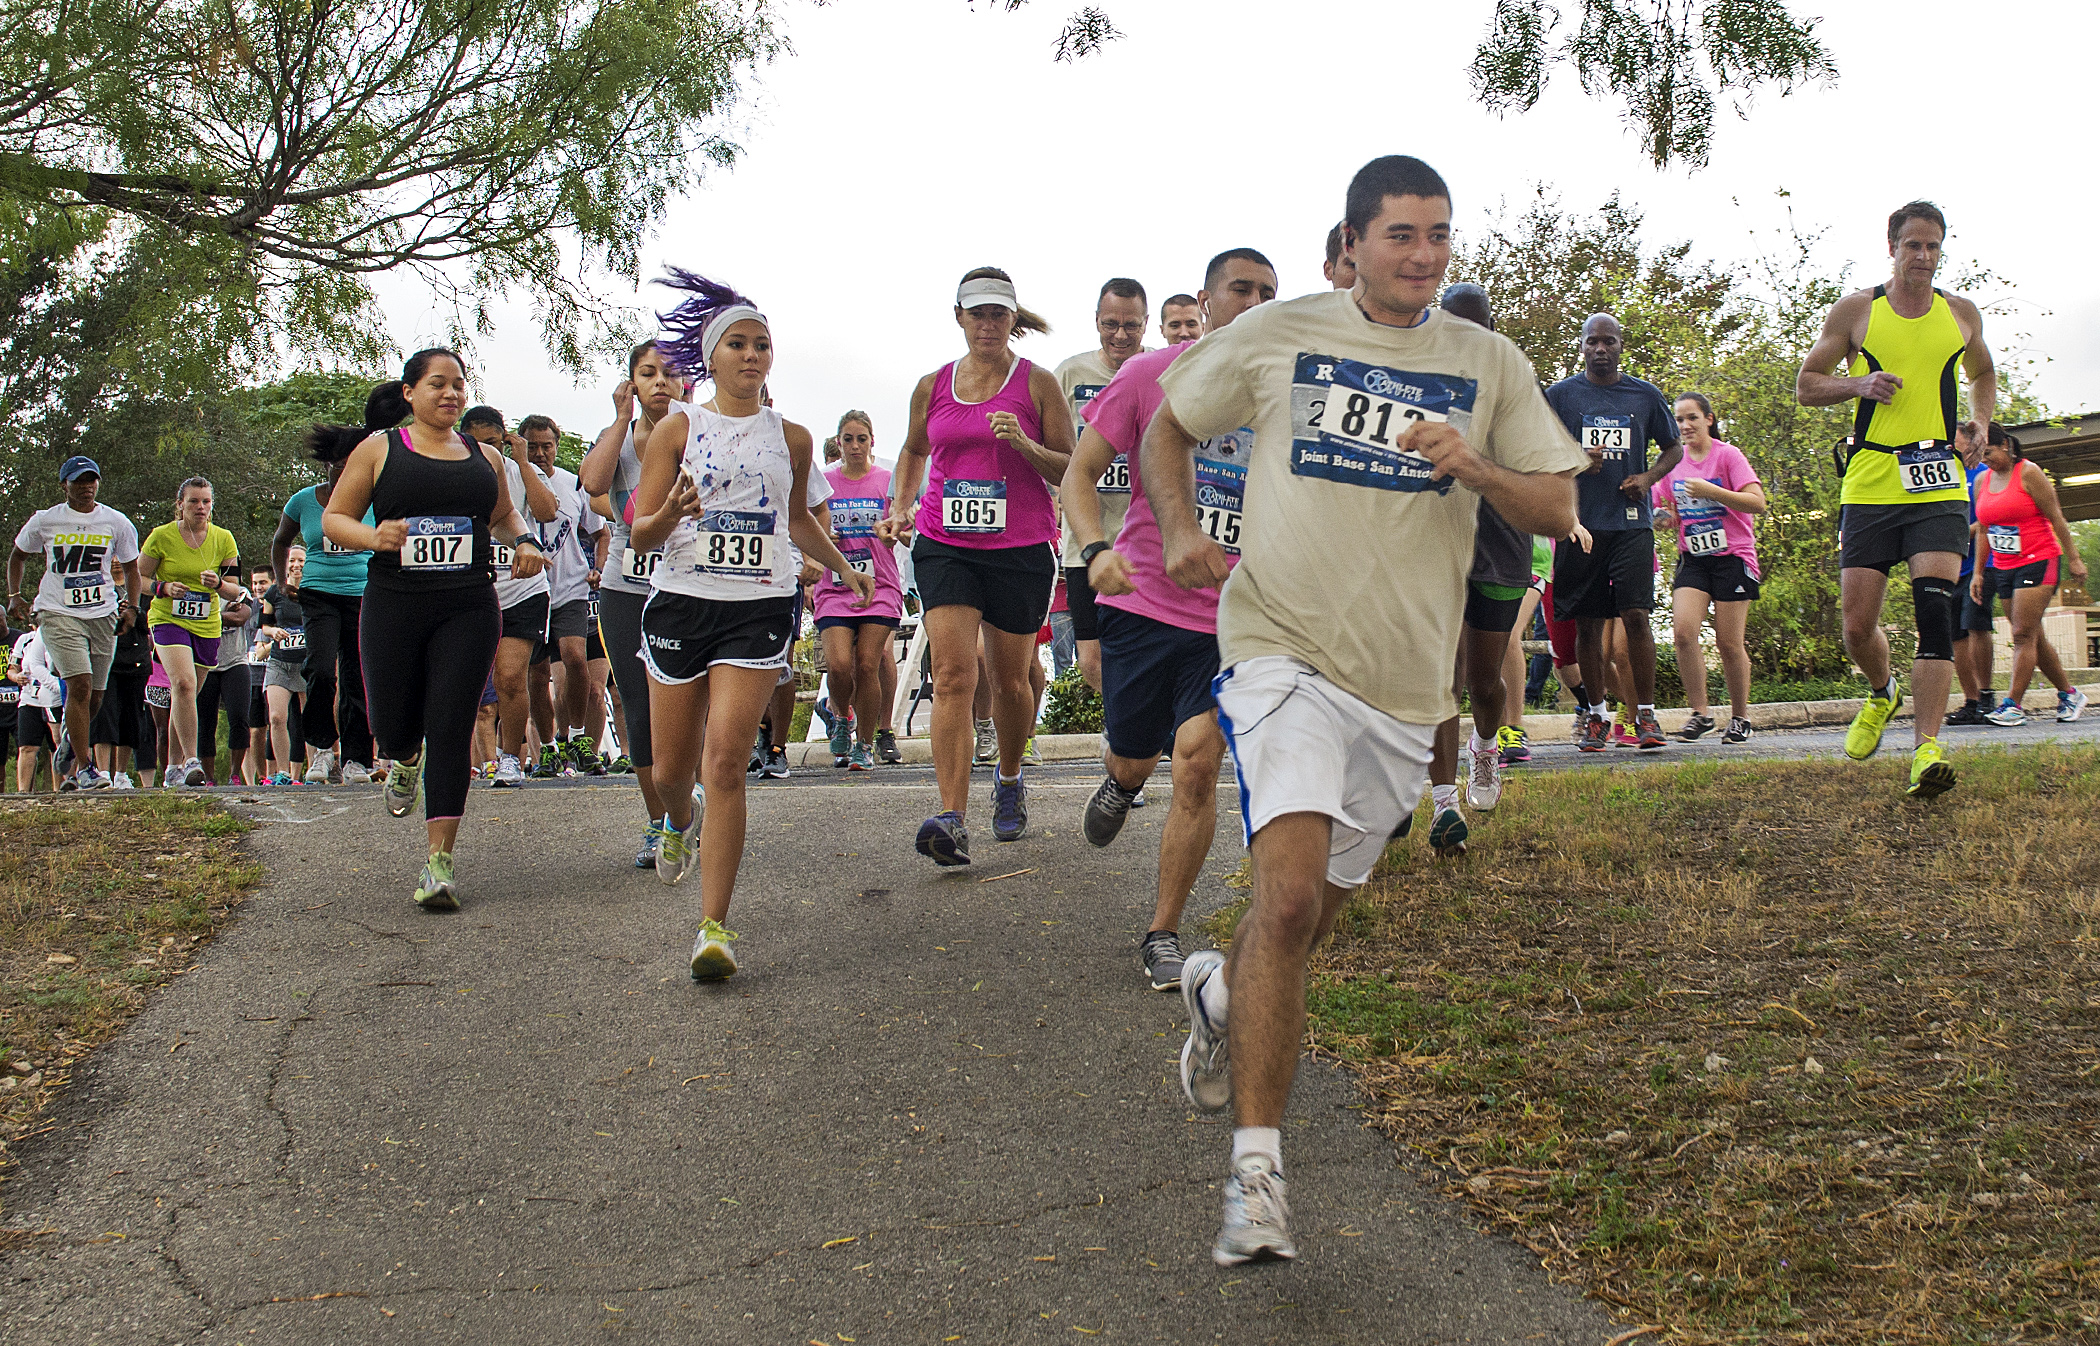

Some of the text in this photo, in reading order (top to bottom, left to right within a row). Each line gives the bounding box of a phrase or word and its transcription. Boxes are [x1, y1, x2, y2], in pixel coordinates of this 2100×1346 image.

[1590, 429, 1622, 446] 873
[1197, 463, 1218, 474] Base
[1221, 467, 1236, 479] San
[1299, 449, 1328, 464] Joint
[1332, 454, 1366, 471] Base
[1369, 460, 1394, 476] San
[1909, 462, 1951, 487] 868
[862, 500, 879, 508] Life
[951, 499, 996, 525] 865
[832, 513, 877, 524] 20 14
[54, 533, 113, 546] DOUBT
[1691, 532, 1719, 552] 816
[413, 536, 463, 563] 807
[708, 534, 763, 566] 839
[51, 545, 107, 574] ME
[72, 587, 101, 604] 814
[178, 600, 204, 616] 851
[283, 634, 305, 647] 872
[648, 634, 682, 651] DANCE
